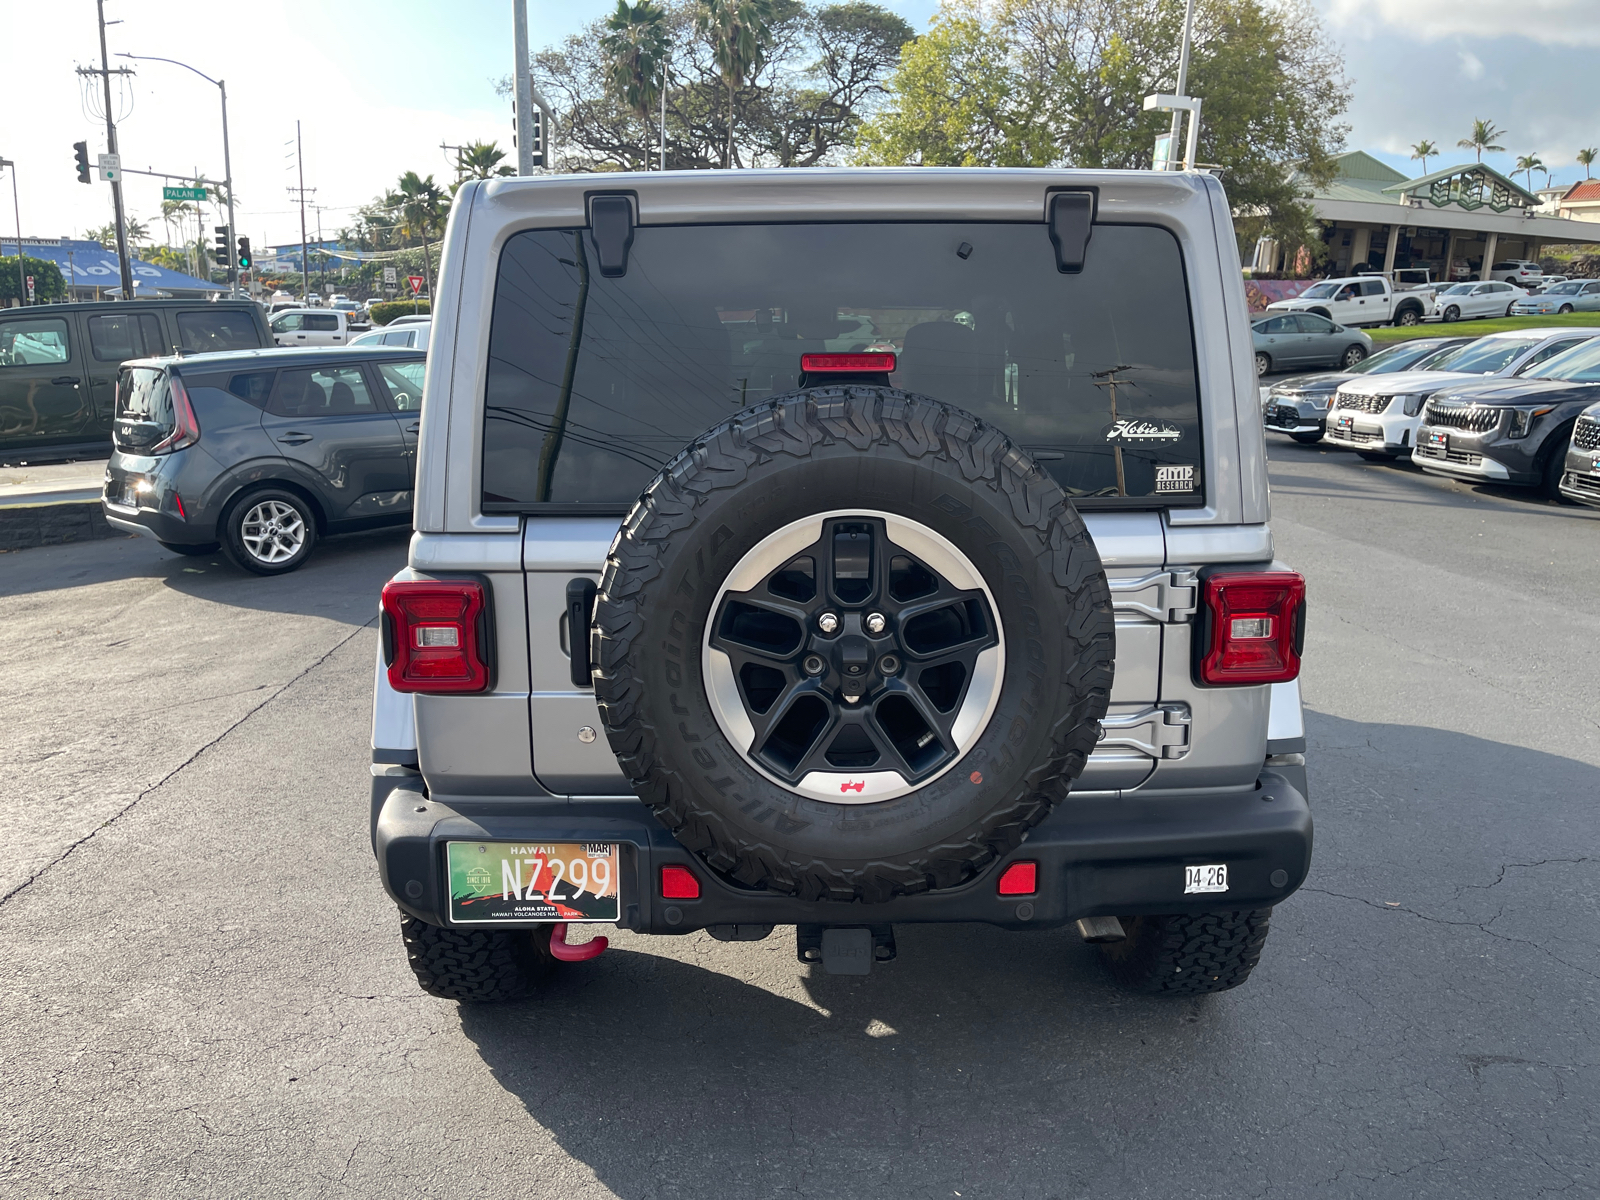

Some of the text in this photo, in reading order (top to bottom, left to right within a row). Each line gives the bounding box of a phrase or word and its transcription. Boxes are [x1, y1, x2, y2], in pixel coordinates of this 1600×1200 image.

[166, 190, 195, 198] PALANI
[1157, 468, 1193, 480] AMP
[1157, 481, 1193, 490] RESEARCH
[510, 847, 556, 855] HAWAII
[588, 844, 608, 853] MAR
[466, 876, 479, 884] SINCE
[501, 858, 611, 901] NZ299
[1208, 867, 1224, 886] 26
